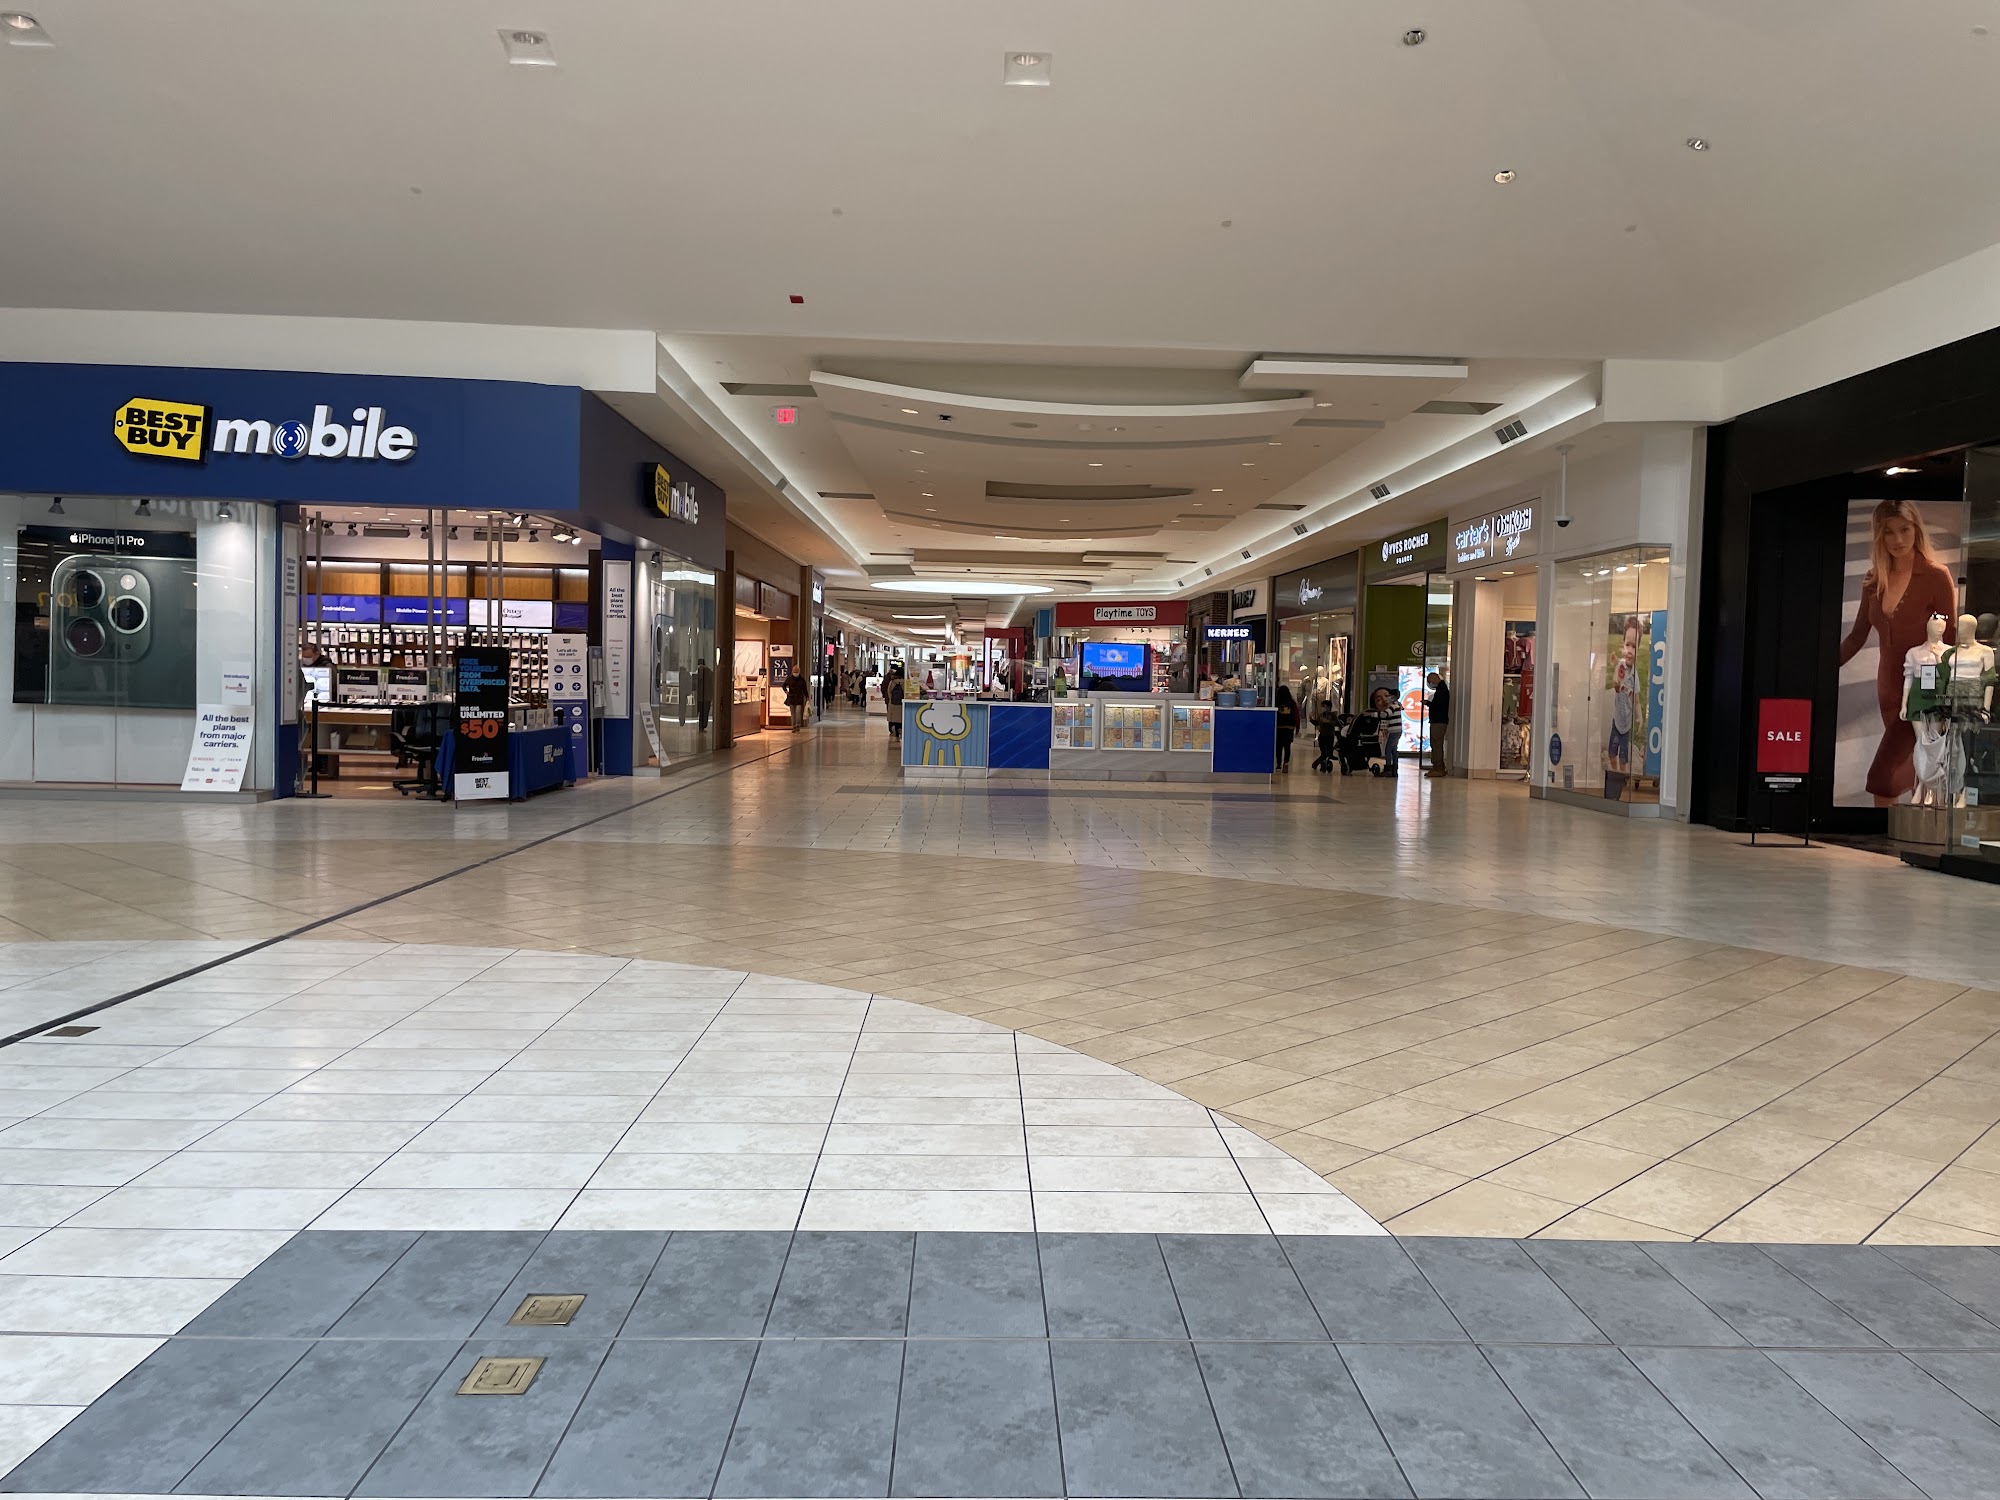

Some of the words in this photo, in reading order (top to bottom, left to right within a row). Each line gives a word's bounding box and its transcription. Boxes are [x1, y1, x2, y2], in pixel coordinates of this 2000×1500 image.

[126, 407, 202, 432] BEST
[127, 426, 195, 450] BUY
[213, 404, 415, 460] mobile
[656, 471, 669, 492] BEST
[657, 486, 669, 508] BUY
[671, 482, 699, 524] mobile
[78, 533, 115, 545] iPhone
[115, 535, 125, 545] 11
[126, 535, 145, 546] Pro
[1455, 518, 1490, 550] carter's
[1388, 540, 1404, 555] YVES
[1403, 532, 1429, 551] ROCHER
[1096, 608, 1132, 619] Playtime
[1135, 607, 1154, 617] TOYS
[1207, 628, 1250, 638] KERNELS
[459, 671, 481, 679] FROM
[459, 678, 506, 686] OVERPRICED
[202, 714, 214, 722] All
[215, 714, 229, 722] the
[230, 715, 249, 723] best
[460, 711, 505, 719] UNLIMITED
[212, 723, 236, 732] plans
[460, 719, 499, 739] $50
[200, 731, 220, 739] from
[221, 732, 247, 741] major
[1767, 730, 1802, 742] SALE
